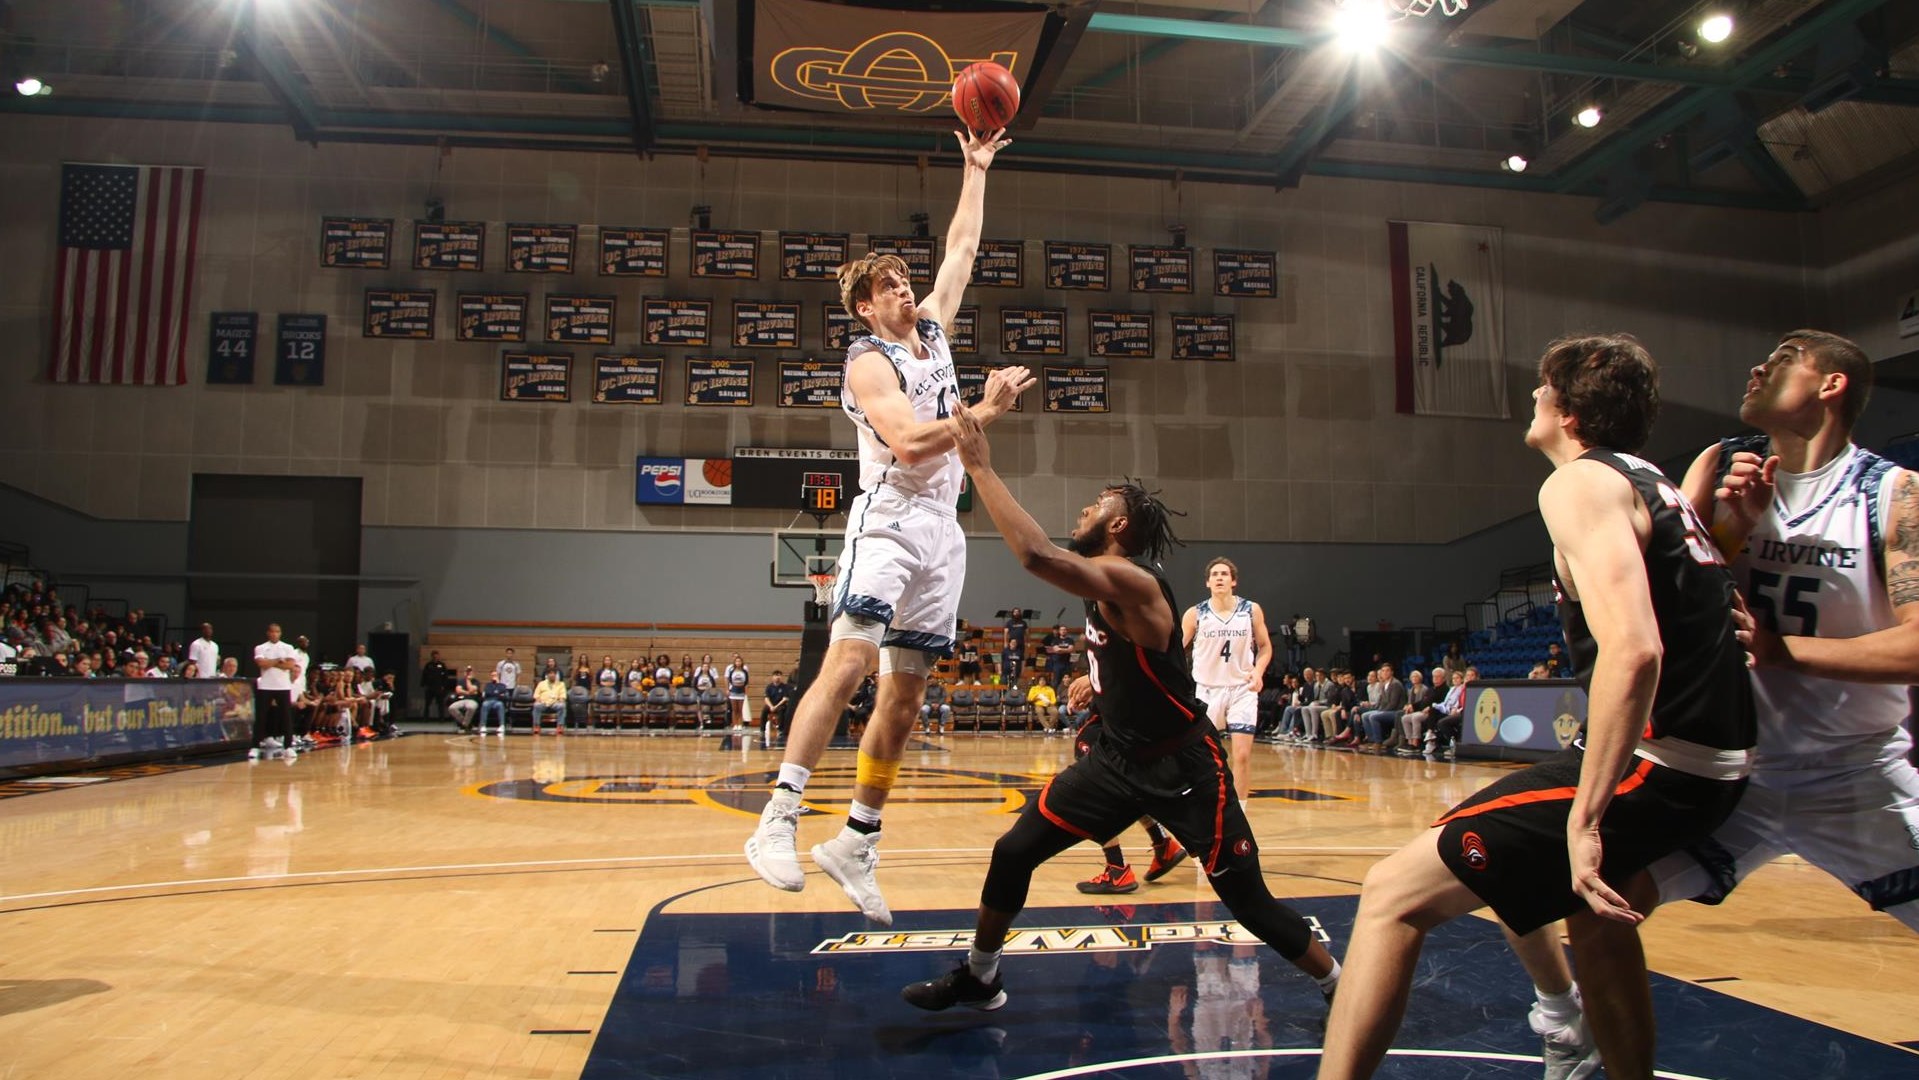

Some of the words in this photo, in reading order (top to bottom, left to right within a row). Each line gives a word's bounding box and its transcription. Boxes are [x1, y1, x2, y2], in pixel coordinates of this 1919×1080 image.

[606, 250, 621, 263] UC
[697, 253, 712, 265] UC
[785, 255, 801, 267] UC
[1051, 264, 1066, 276] UC
[1135, 268, 1149, 280] UC
[1219, 272, 1234, 284] UC
[1416, 266, 1427, 317] CALIFORNIA
[552, 318, 567, 330] UC
[648, 320, 664, 333] UC
[738, 322, 754, 335] UC
[216, 329, 251, 338] MAGEE
[282, 331, 322, 340] BROOKS
[1006, 329, 1021, 341] UC
[1095, 333, 1110, 344] UC
[1177, 335, 1192, 347] UC
[1417, 325, 1428, 367] REPUBLIC
[216, 340, 248, 357] 44
[287, 341, 315, 359] 12
[509, 375, 525, 387] UC
[600, 378, 616, 391] UC
[617, 374, 656, 386] IRVINE
[691, 380, 708, 392] UC
[709, 377, 748, 388] IRVINE
[784, 382, 799, 394] UC
[801, 378, 840, 389] IRVINE
[960, 386, 975, 398] UC
[1048, 389, 1064, 400] UC
[1066, 385, 1103, 396] IRVINE
[739, 449, 770, 457] BREN
[778, 450, 822, 459] EVENTS
[829, 451, 859, 460] CENT
[641, 465, 682, 476] PEPSI
[817, 488, 835, 509] 18
[1759, 539, 1860, 569] IRVINE
[1749, 568, 1821, 637] 55
[1203, 631, 1216, 639] UC
[1217, 629, 1248, 638] IRVINE
[1220, 639, 1232, 663] 4
[84, 703, 113, 733] but
[117, 709, 146, 730] our
